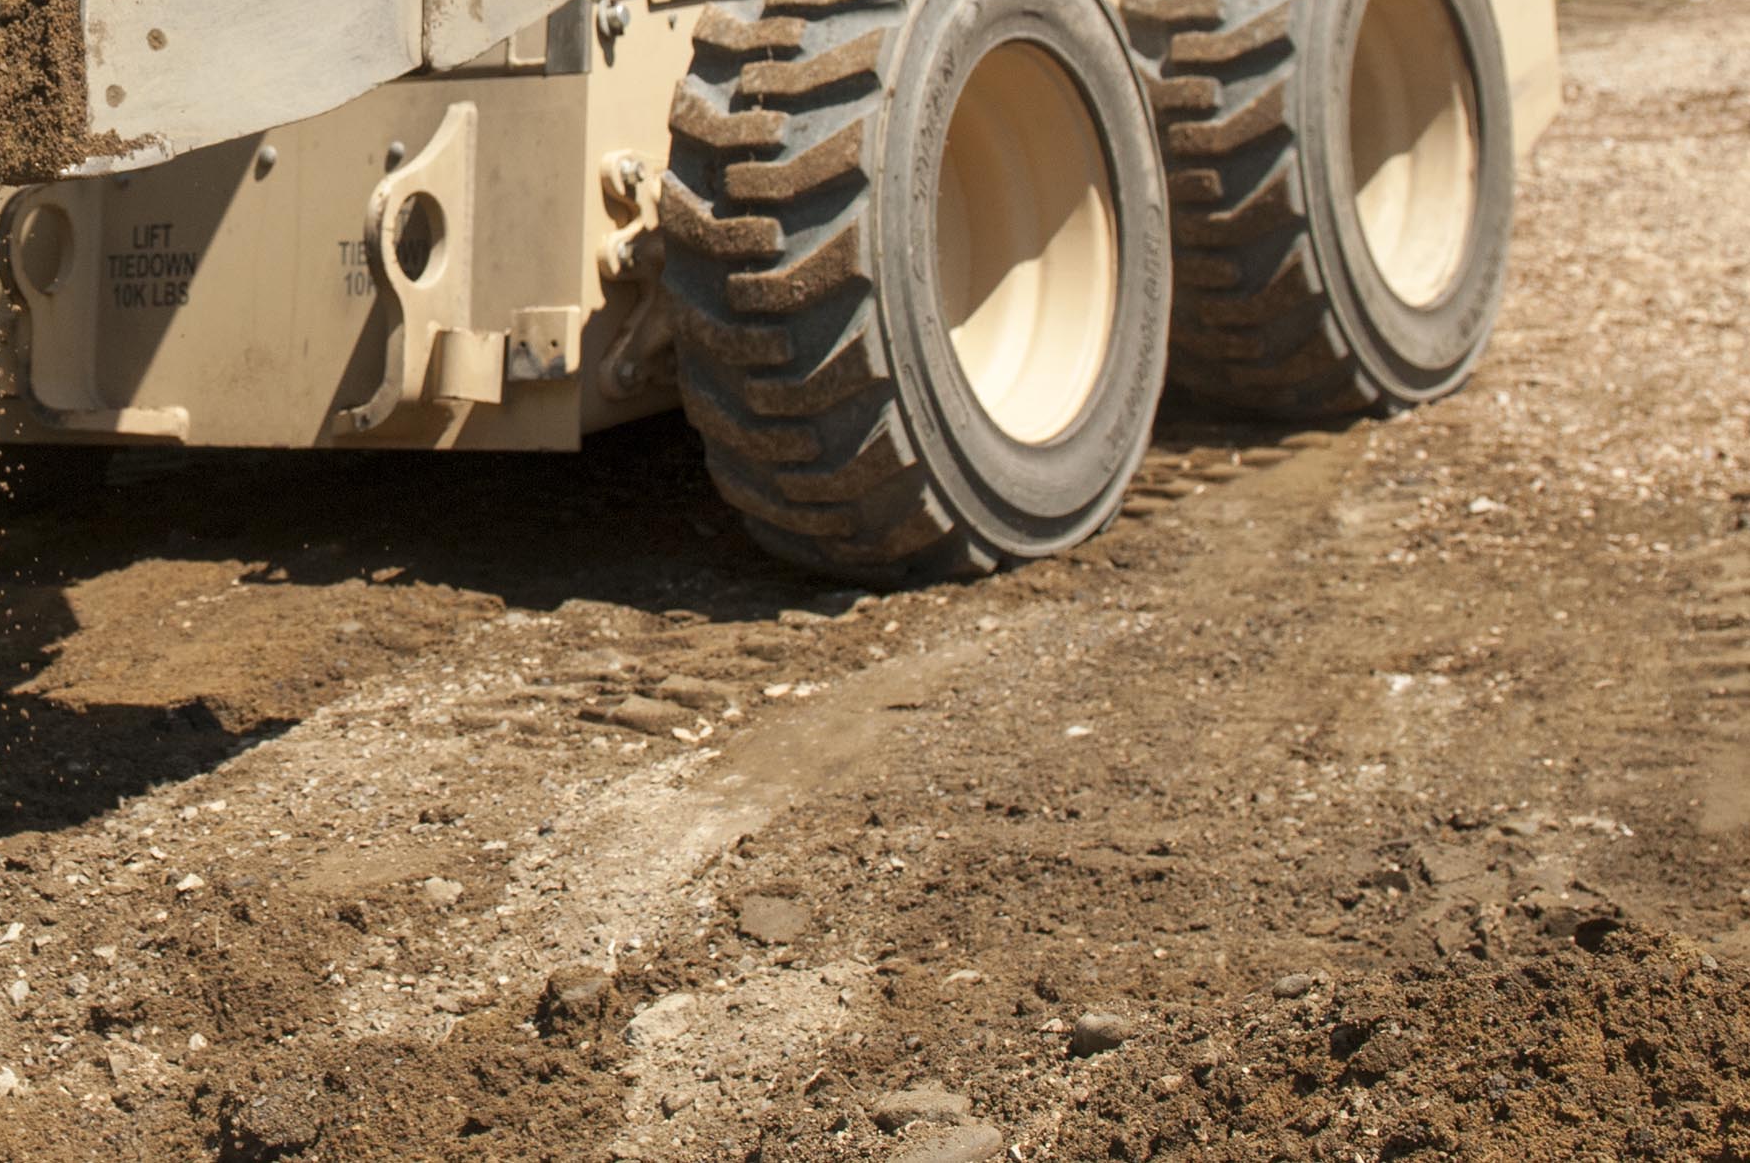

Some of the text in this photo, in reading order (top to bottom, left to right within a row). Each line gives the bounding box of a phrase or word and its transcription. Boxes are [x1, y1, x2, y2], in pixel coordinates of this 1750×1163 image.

[133, 223, 173, 249] LIFT
[107, 253, 196, 278] TIEDOWN
[114, 281, 189, 308] 10K LBS
